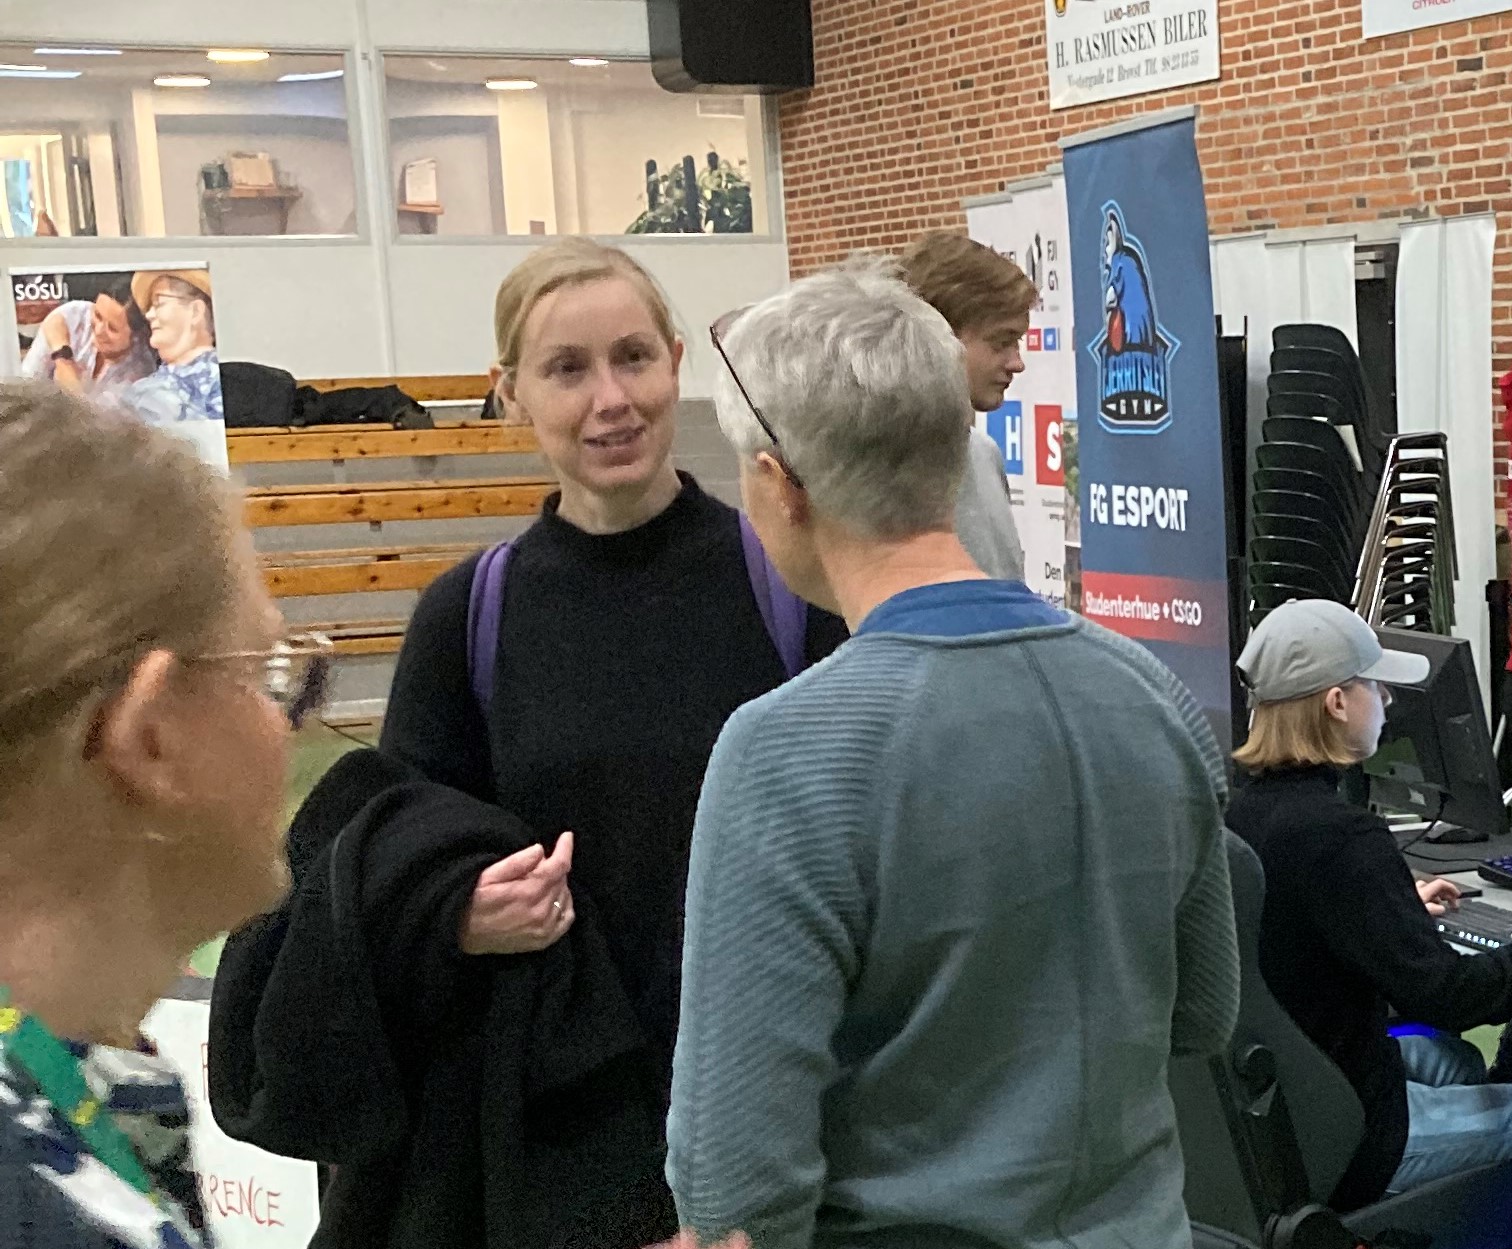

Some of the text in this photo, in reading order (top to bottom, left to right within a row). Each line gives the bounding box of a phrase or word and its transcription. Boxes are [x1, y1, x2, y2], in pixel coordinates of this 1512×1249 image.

[1412, 0, 1456, 10] CITRO
[1056, 9, 1208, 69] H. RASMUSSEN BILER
[1120, 399, 1152, 415] GYM
[1089, 483, 1109, 525] FG
[1111, 485, 1189, 532] ESPORT
[1085, 591, 1161, 622] Studenterhue
[200, 1174, 285, 1227] RENCE
